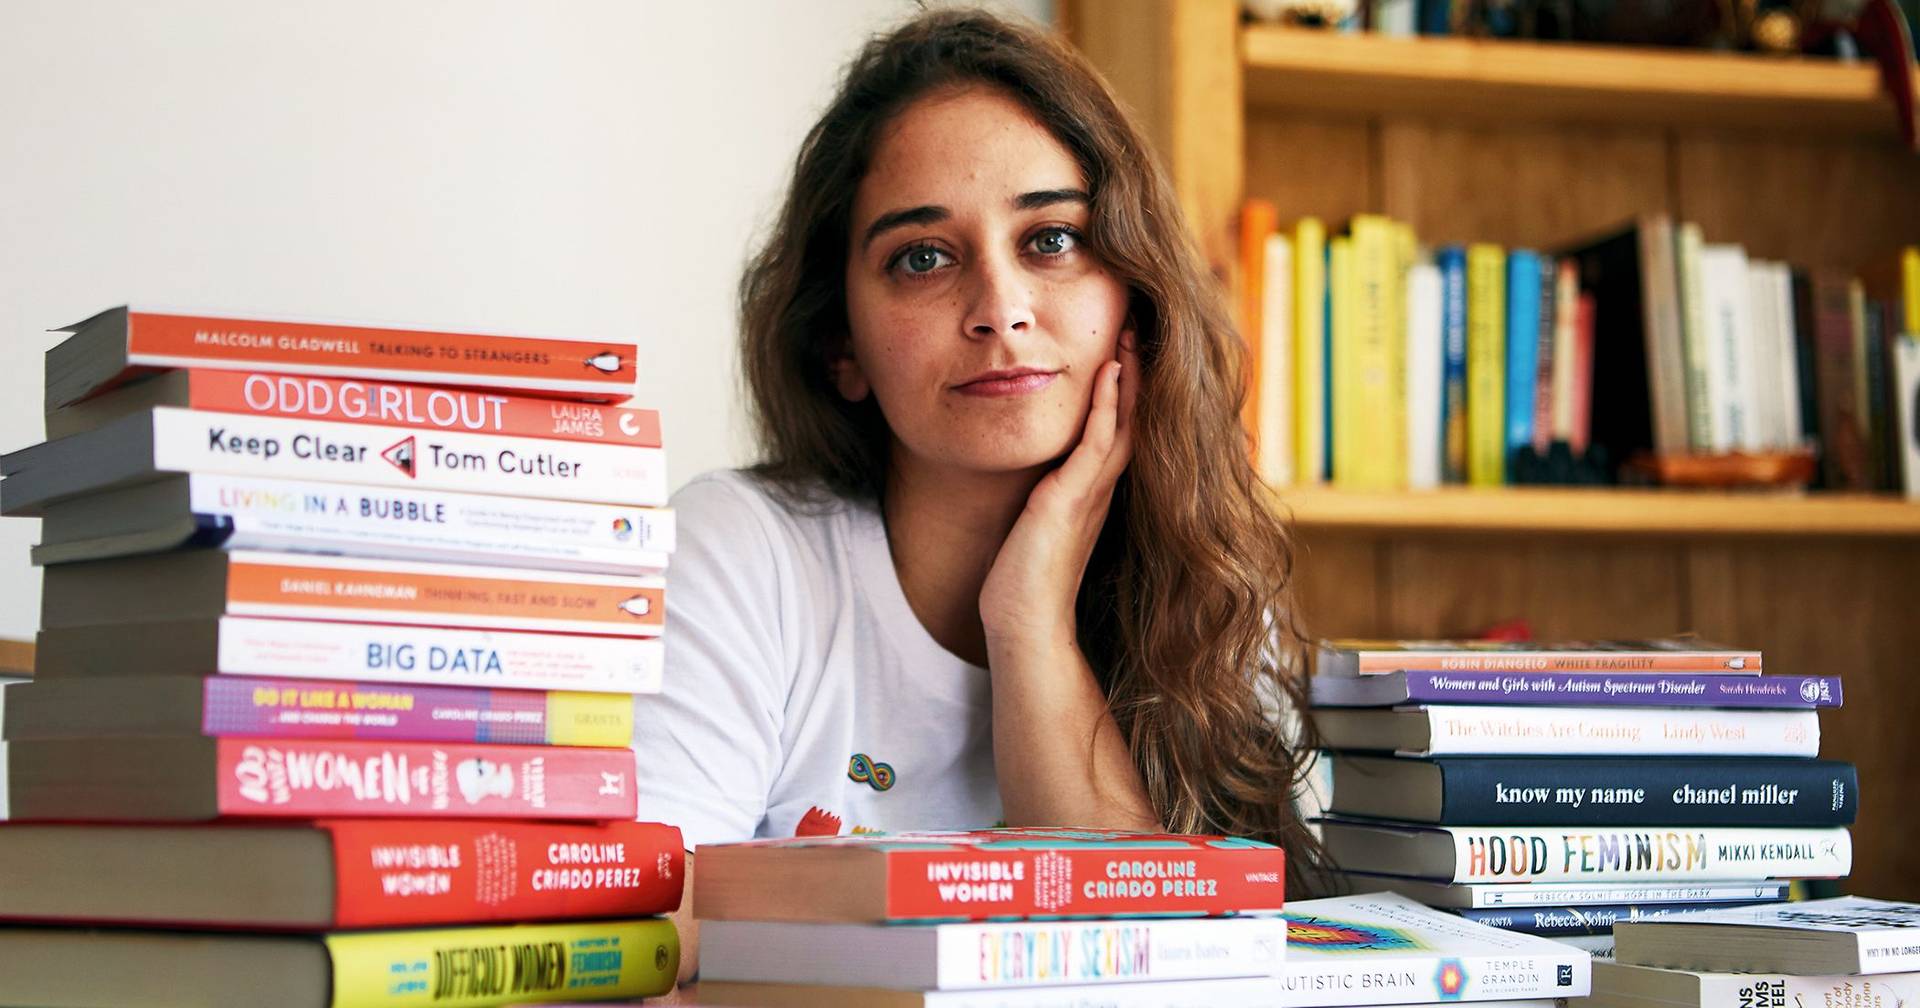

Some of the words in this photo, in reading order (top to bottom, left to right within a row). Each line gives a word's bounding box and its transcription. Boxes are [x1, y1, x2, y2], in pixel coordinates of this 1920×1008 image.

[194, 331, 273, 347] MALCOLM
[278, 335, 361, 354] GLADWELL
[369, 342, 433, 358] TALKING
[440, 347, 459, 359] TO
[464, 348, 550, 365] STRANGERS
[551, 404, 602, 422] LAURA
[551, 420, 604, 437] JAMES
[208, 428, 280, 459] Keep
[292, 434, 367, 462] Clear
[429, 444, 486, 471] Tom
[498, 449, 582, 478] Cutler
[219, 487, 294, 513] LIVING
[304, 495, 326, 513] IN
[336, 498, 349, 515] A
[360, 498, 446, 523] BUBBLE
[280, 578, 332, 596] DANIEL
[497, 590, 526, 605] FAST
[531, 591, 556, 606] AND
[560, 592, 598, 609] SLOW
[366, 642, 416, 670] BIG
[429, 646, 503, 675] DATA
[1441, 658, 1480, 670] ROBIN
[1554, 658, 1591, 670] WHITE
[1595, 658, 1654, 670] FRAGILITY
[1430, 676, 1475, 692] Women
[1478, 677, 1500, 692] and
[1502, 677, 1529, 695] Girls
[1530, 676, 1555, 692] with
[1558, 678, 1600, 693] Autism
[1603, 679, 1656, 696] Spectrum
[1657, 679, 1706, 695] Disorder
[1719, 683, 1744, 695] Sarah
[253, 687, 279, 707] DO
[281, 688, 298, 707] IT
[300, 689, 336, 709] LIKE
[337, 690, 350, 709] A
[352, 691, 415, 711] WOMAN
[1446, 720, 1476, 737] The
[1481, 720, 1544, 738] Witches
[1549, 721, 1574, 739] Are
[1578, 721, 1641, 743] Coming
[1663, 720, 1706, 742] Lindy
[1709, 722, 1745, 740] West
[286, 750, 411, 805] WOMEN
[1495, 782, 1550, 804] know
[1555, 787, 1586, 807] my
[1590, 787, 1646, 804] name
[1672, 783, 1736, 804] chanel
[1741, 783, 1799, 805] miller
[371, 844, 461, 869] INVISIBLE
[548, 842, 625, 865] CAROLINE
[1468, 835, 1548, 876] HOOD
[1562, 831, 1708, 873] FEMINISM
[1718, 844, 1755, 862] MIKKI
[1760, 843, 1815, 860] KENDALL
[532, 868, 593, 891] CRIADO
[594, 867, 641, 889] PEREZ
[927, 860, 1025, 881] INVISIBLE
[1105, 860, 1196, 880] CAROLINE
[1244, 871, 1280, 884] VINTAGE
[382, 872, 451, 896] WOMEN
[938, 882, 1014, 902] WOMEN
[1083, 880, 1157, 899] CRIADO
[1162, 879, 1218, 897] PEREZ
[1665, 888, 1682, 899] THE
[1686, 887, 1712, 898] DARK
[1534, 911, 1582, 929] Rebecca
[1583, 909, 1617, 927] Solnit
[979, 931, 1073, 982] EVERYDAY
[1080, 927, 1150, 977] SEXISM
[1866, 947, 1880, 959] WHY
[1891, 946, 1901, 957] NO
[1486, 959, 1534, 971] TEMPLE
[1361, 971, 1416, 988] BRAIN
[1482, 973, 1540, 985] GRANDIN
